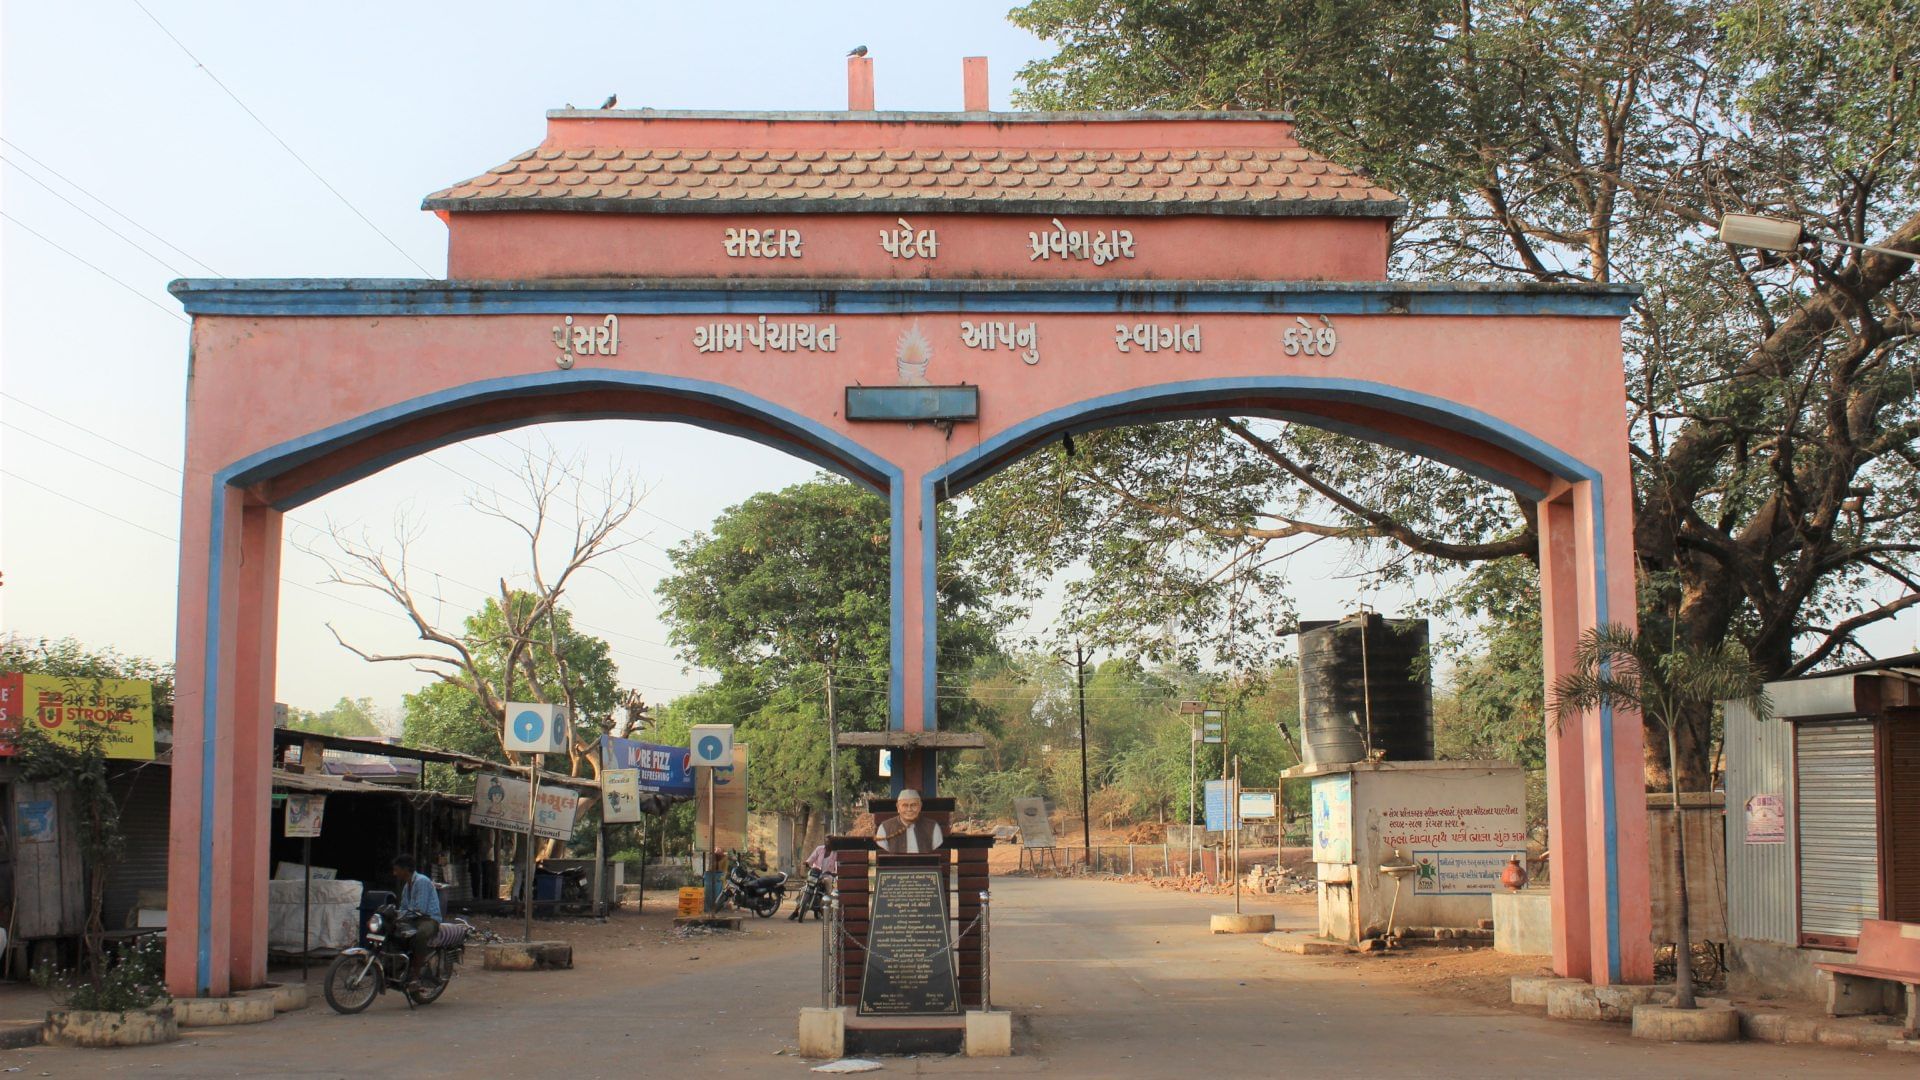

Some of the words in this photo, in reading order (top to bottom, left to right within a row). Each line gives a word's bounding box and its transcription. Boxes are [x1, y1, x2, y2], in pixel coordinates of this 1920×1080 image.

[723, 227, 803, 259] સરદાર
[879, 217, 937, 259] પટેલ
[1029, 218, 1136, 266] પ્રવેશદ્વાર
[960, 321, 1040, 365] આપનુ
[1115, 323, 1201, 353] સ્વાગત
[652, 750, 671, 771] FIZZ
